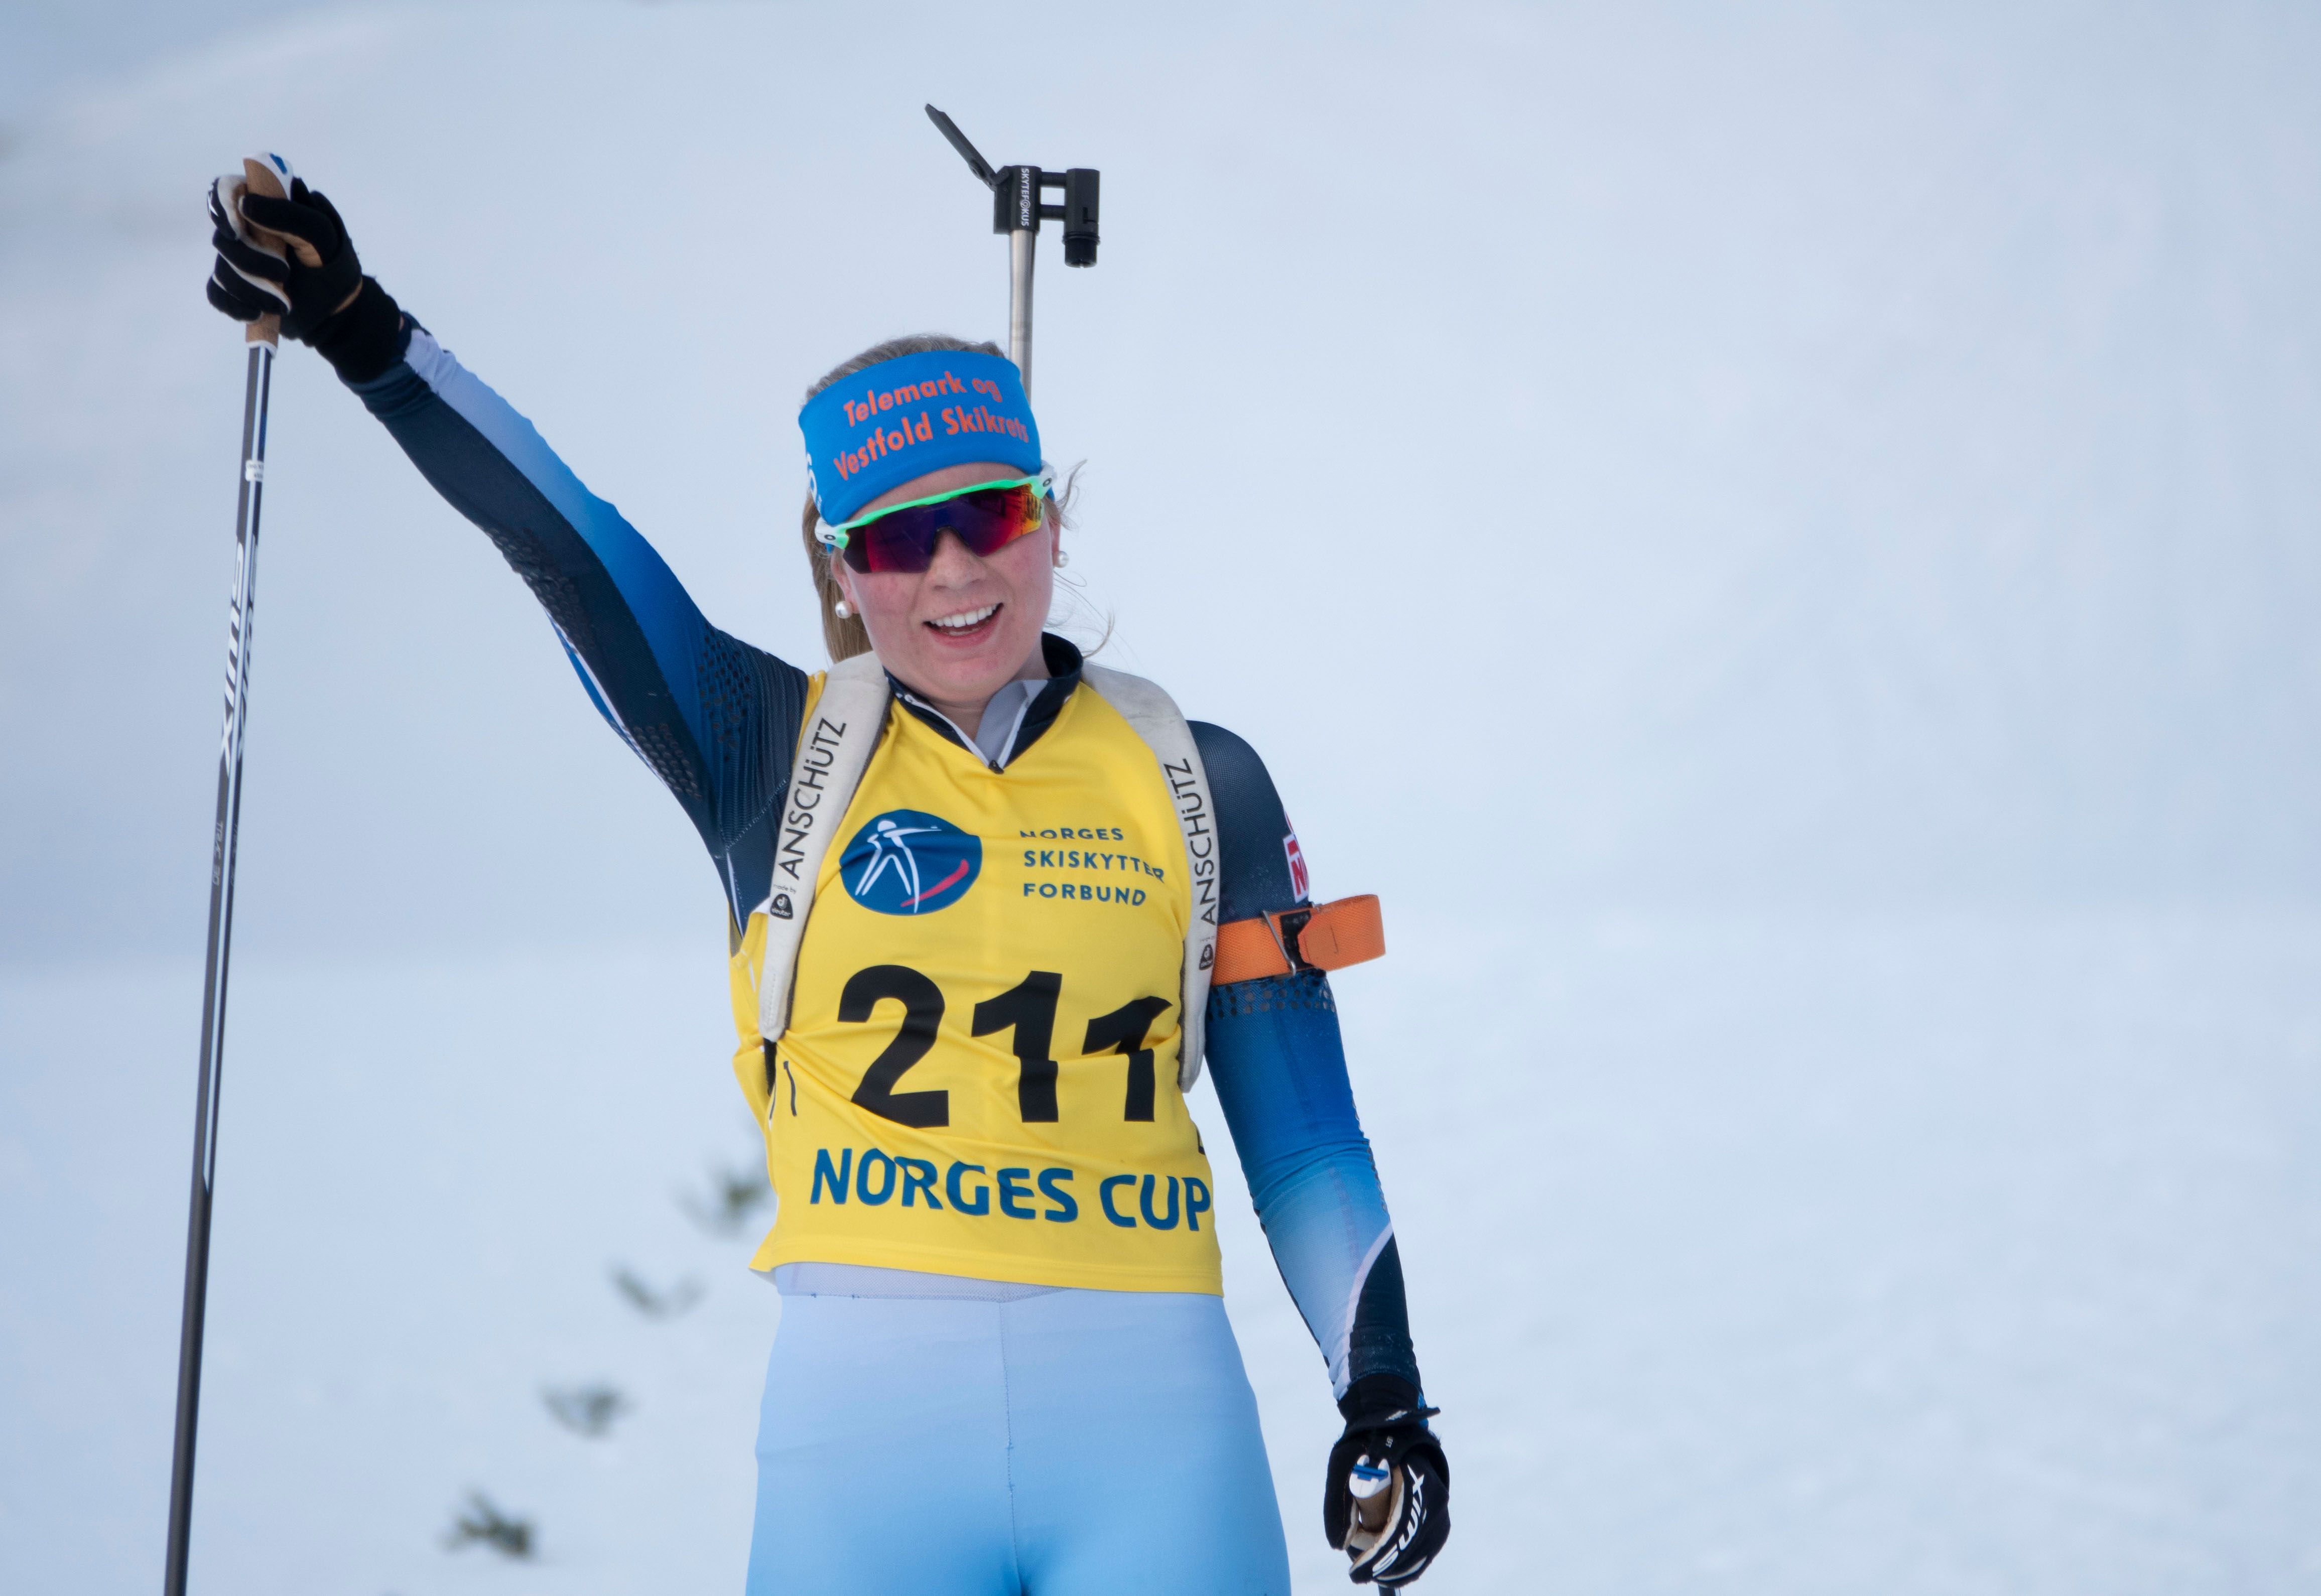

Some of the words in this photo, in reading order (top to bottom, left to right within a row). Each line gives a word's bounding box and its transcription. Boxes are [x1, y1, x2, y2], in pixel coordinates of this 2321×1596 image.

[843, 371, 967, 427] Telemark
[972, 378, 1002, 403] og
[834, 412, 933, 481] Vestfold
[942, 406, 1029, 443] Skikrets
[779, 718, 846, 880] ANSCHÜTZ
[1020, 828, 1124, 841] NORGES
[1024, 851, 1165, 884] SKISKYTTER
[1164, 758, 1217, 925] ANSCHÜTZ
[1023, 883, 1146, 906] FORBUND
[838, 964, 1173, 1128] 211
[810, 1147, 1079, 1224] NORGES
[1099, 1174, 1211, 1232] CUP
